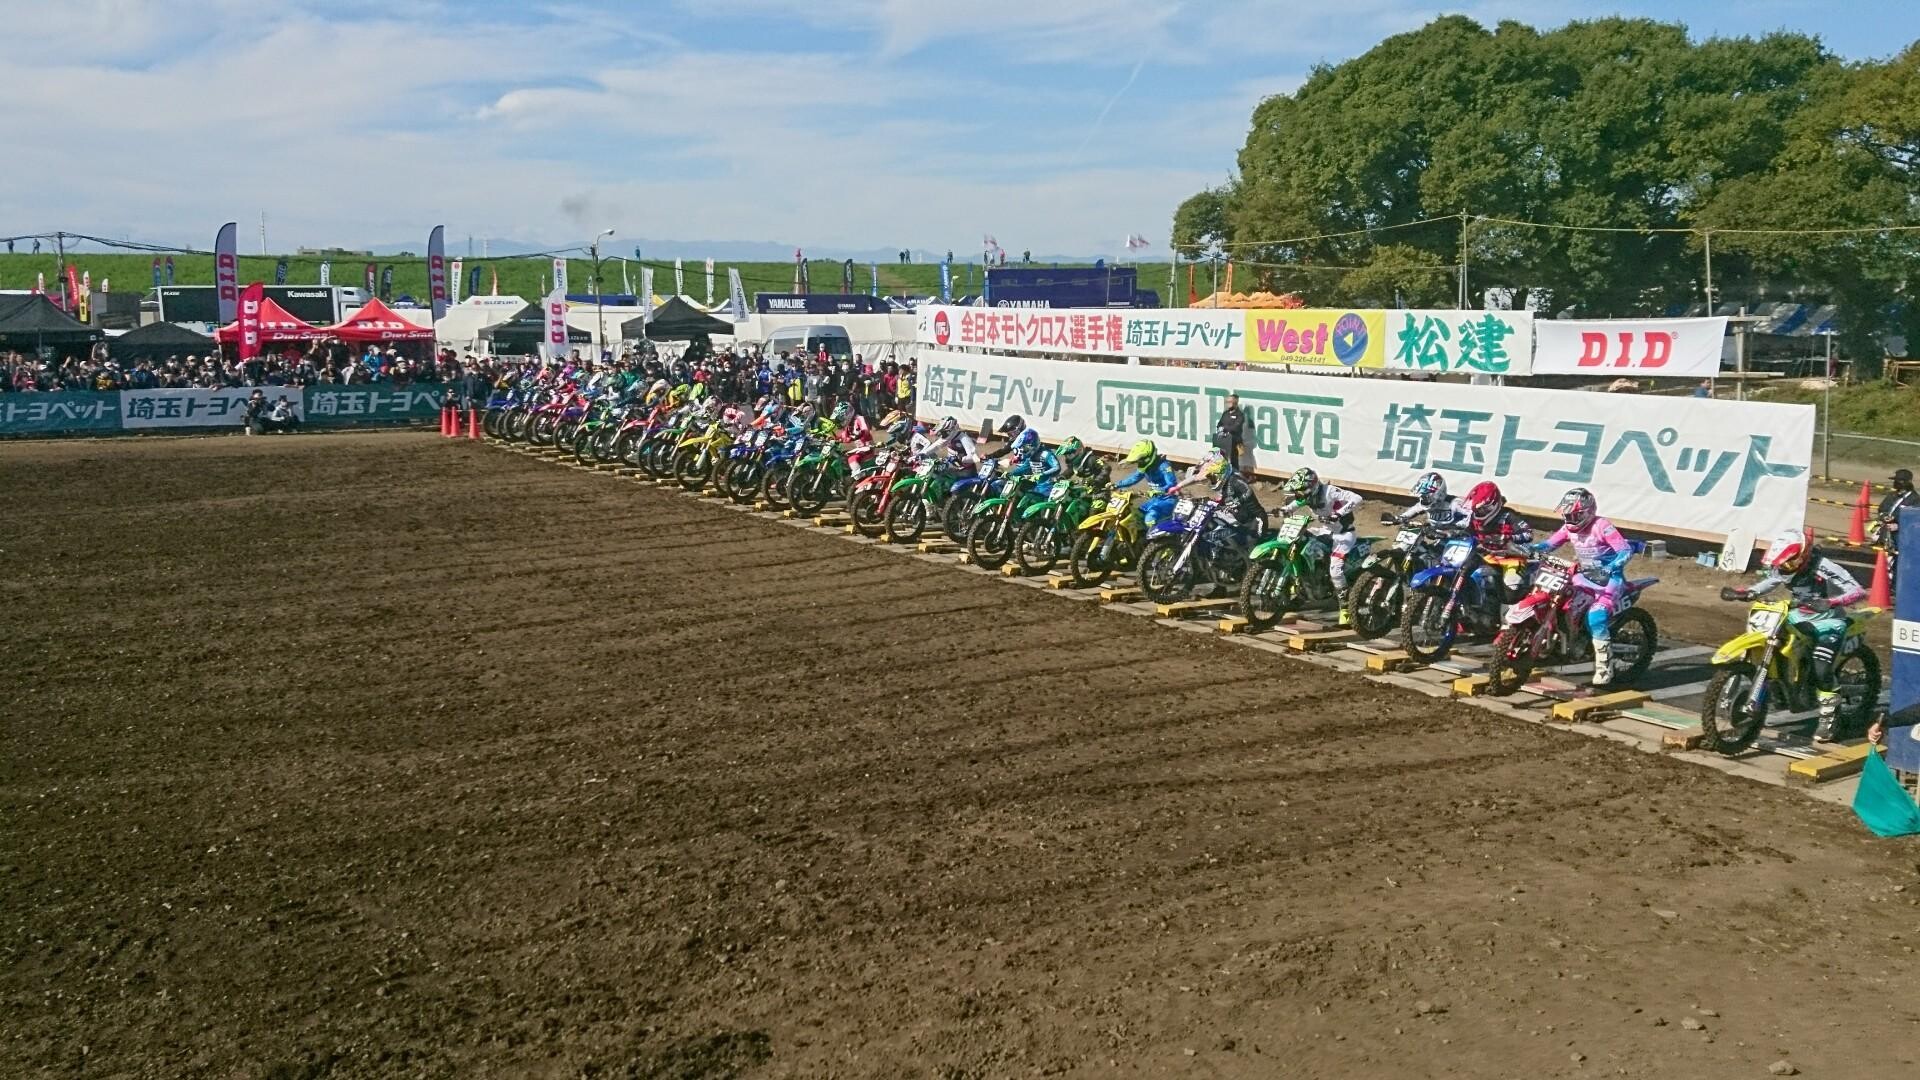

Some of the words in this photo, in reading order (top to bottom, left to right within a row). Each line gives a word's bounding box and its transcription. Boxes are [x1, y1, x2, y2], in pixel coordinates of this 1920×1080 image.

[287, 290, 328, 298] Kawasaki
[768, 298, 807, 309] YAMALUBE
[1009, 299, 1051, 309] YAMAHA
[960, 311, 1124, 351] 全日本モトクロス選手権
[1126, 319, 1242, 349] 埼玉トヨペット
[1257, 318, 1329, 355] West
[1393, 311, 1515, 373] 松建
[0, 399, 116, 422] トヨペット
[922, 363, 1077, 422] 埼玉トヨペット
[1096, 379, 1200, 442] Green
[1376, 402, 1809, 507] 埼玉トヨペット
